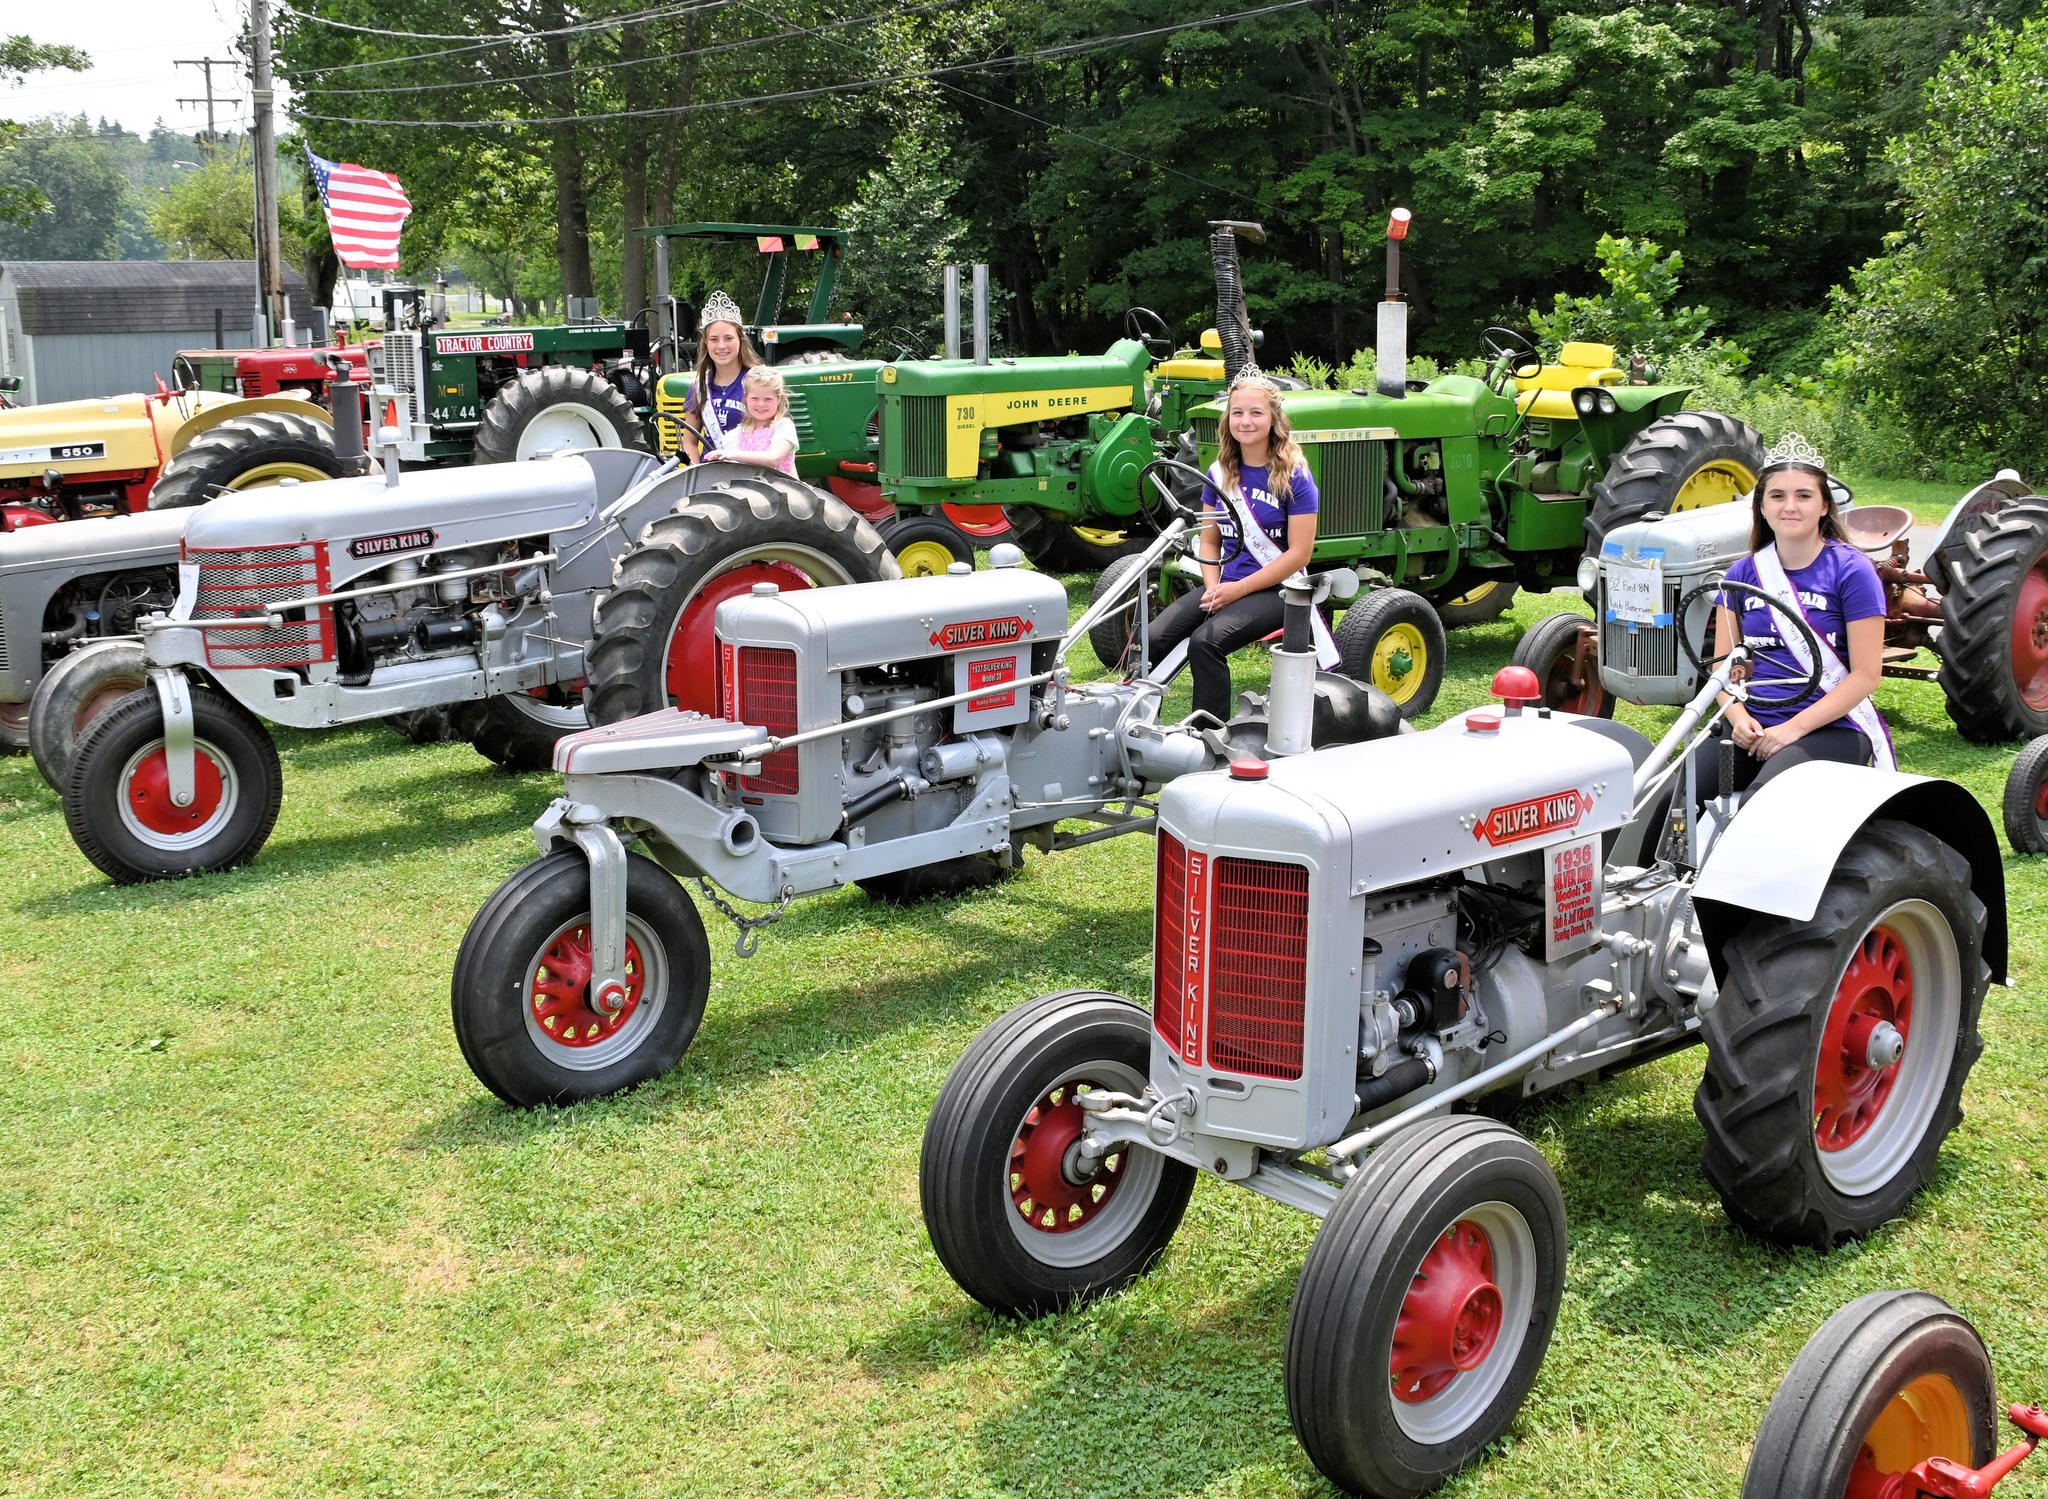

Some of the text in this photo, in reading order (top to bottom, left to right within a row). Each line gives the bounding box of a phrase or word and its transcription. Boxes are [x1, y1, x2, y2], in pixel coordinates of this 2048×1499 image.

[440, 335, 529, 352] TRACTOR COUNTRY
[842, 373, 854, 382] 77
[1007, 396, 1088, 409] JOHN DEERE
[432, 407, 449, 420] 44
[459, 405, 476, 419] 44
[956, 406, 975, 421] 730
[1292, 431, 1371, 442] OHN DEERE
[61, 446, 93, 458] 550
[1251, 487, 1279, 509] FAIR
[356, 531, 430, 555] SILVER KING
[1622, 580, 1637, 592] Ford
[1638, 583, 1650, 593] 8N
[946, 620, 1018, 644] SILVER KING
[972, 661, 1013, 674] 1937 SILVER KING
[982, 674, 996, 683] Model
[1494, 795, 1576, 837] SILVER KING
[1554, 844, 1592, 873] 1936
[1553, 863, 1594, 892] SILVER KING
[1558, 896, 1591, 913] Owners
[1188, 857, 1203, 974] SILVER
[1186, 983, 1199, 1059] KING
